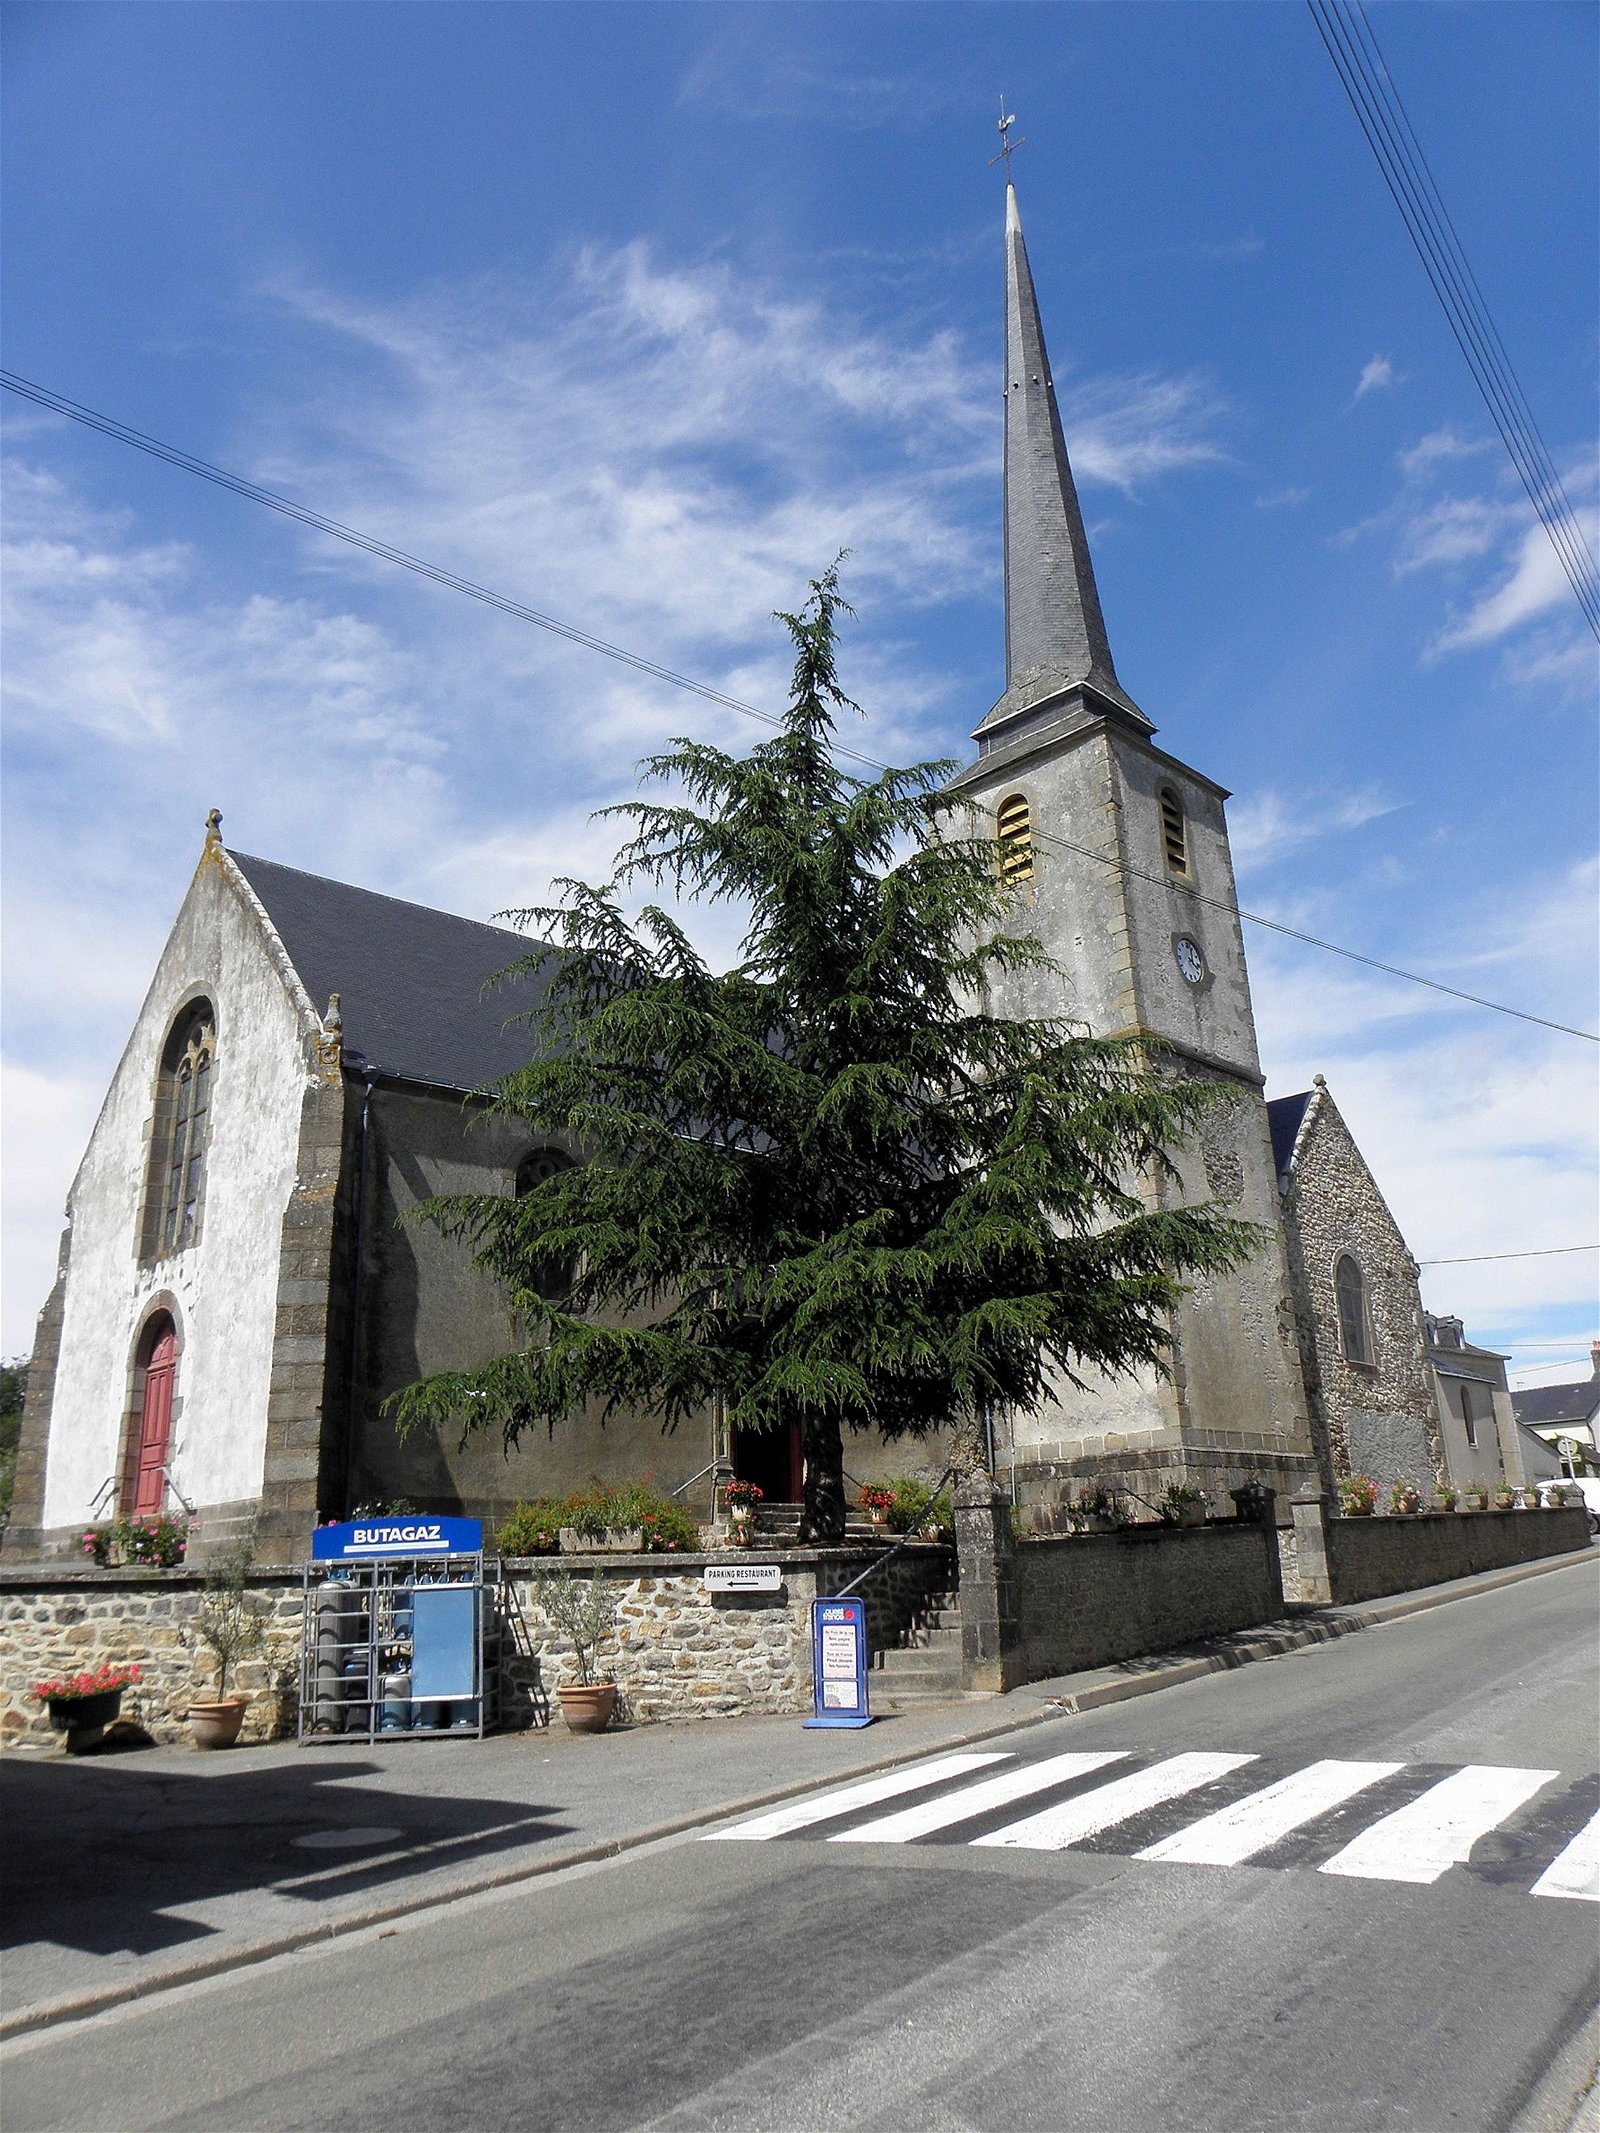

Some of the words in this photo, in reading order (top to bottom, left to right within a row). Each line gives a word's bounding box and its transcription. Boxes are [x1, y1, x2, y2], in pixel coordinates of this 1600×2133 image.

[353, 1525, 441, 1544] BUTAGAZ
[708, 1570, 735, 1578] PARKING
[736, 1569, 776, 1578] RESTAURANT
